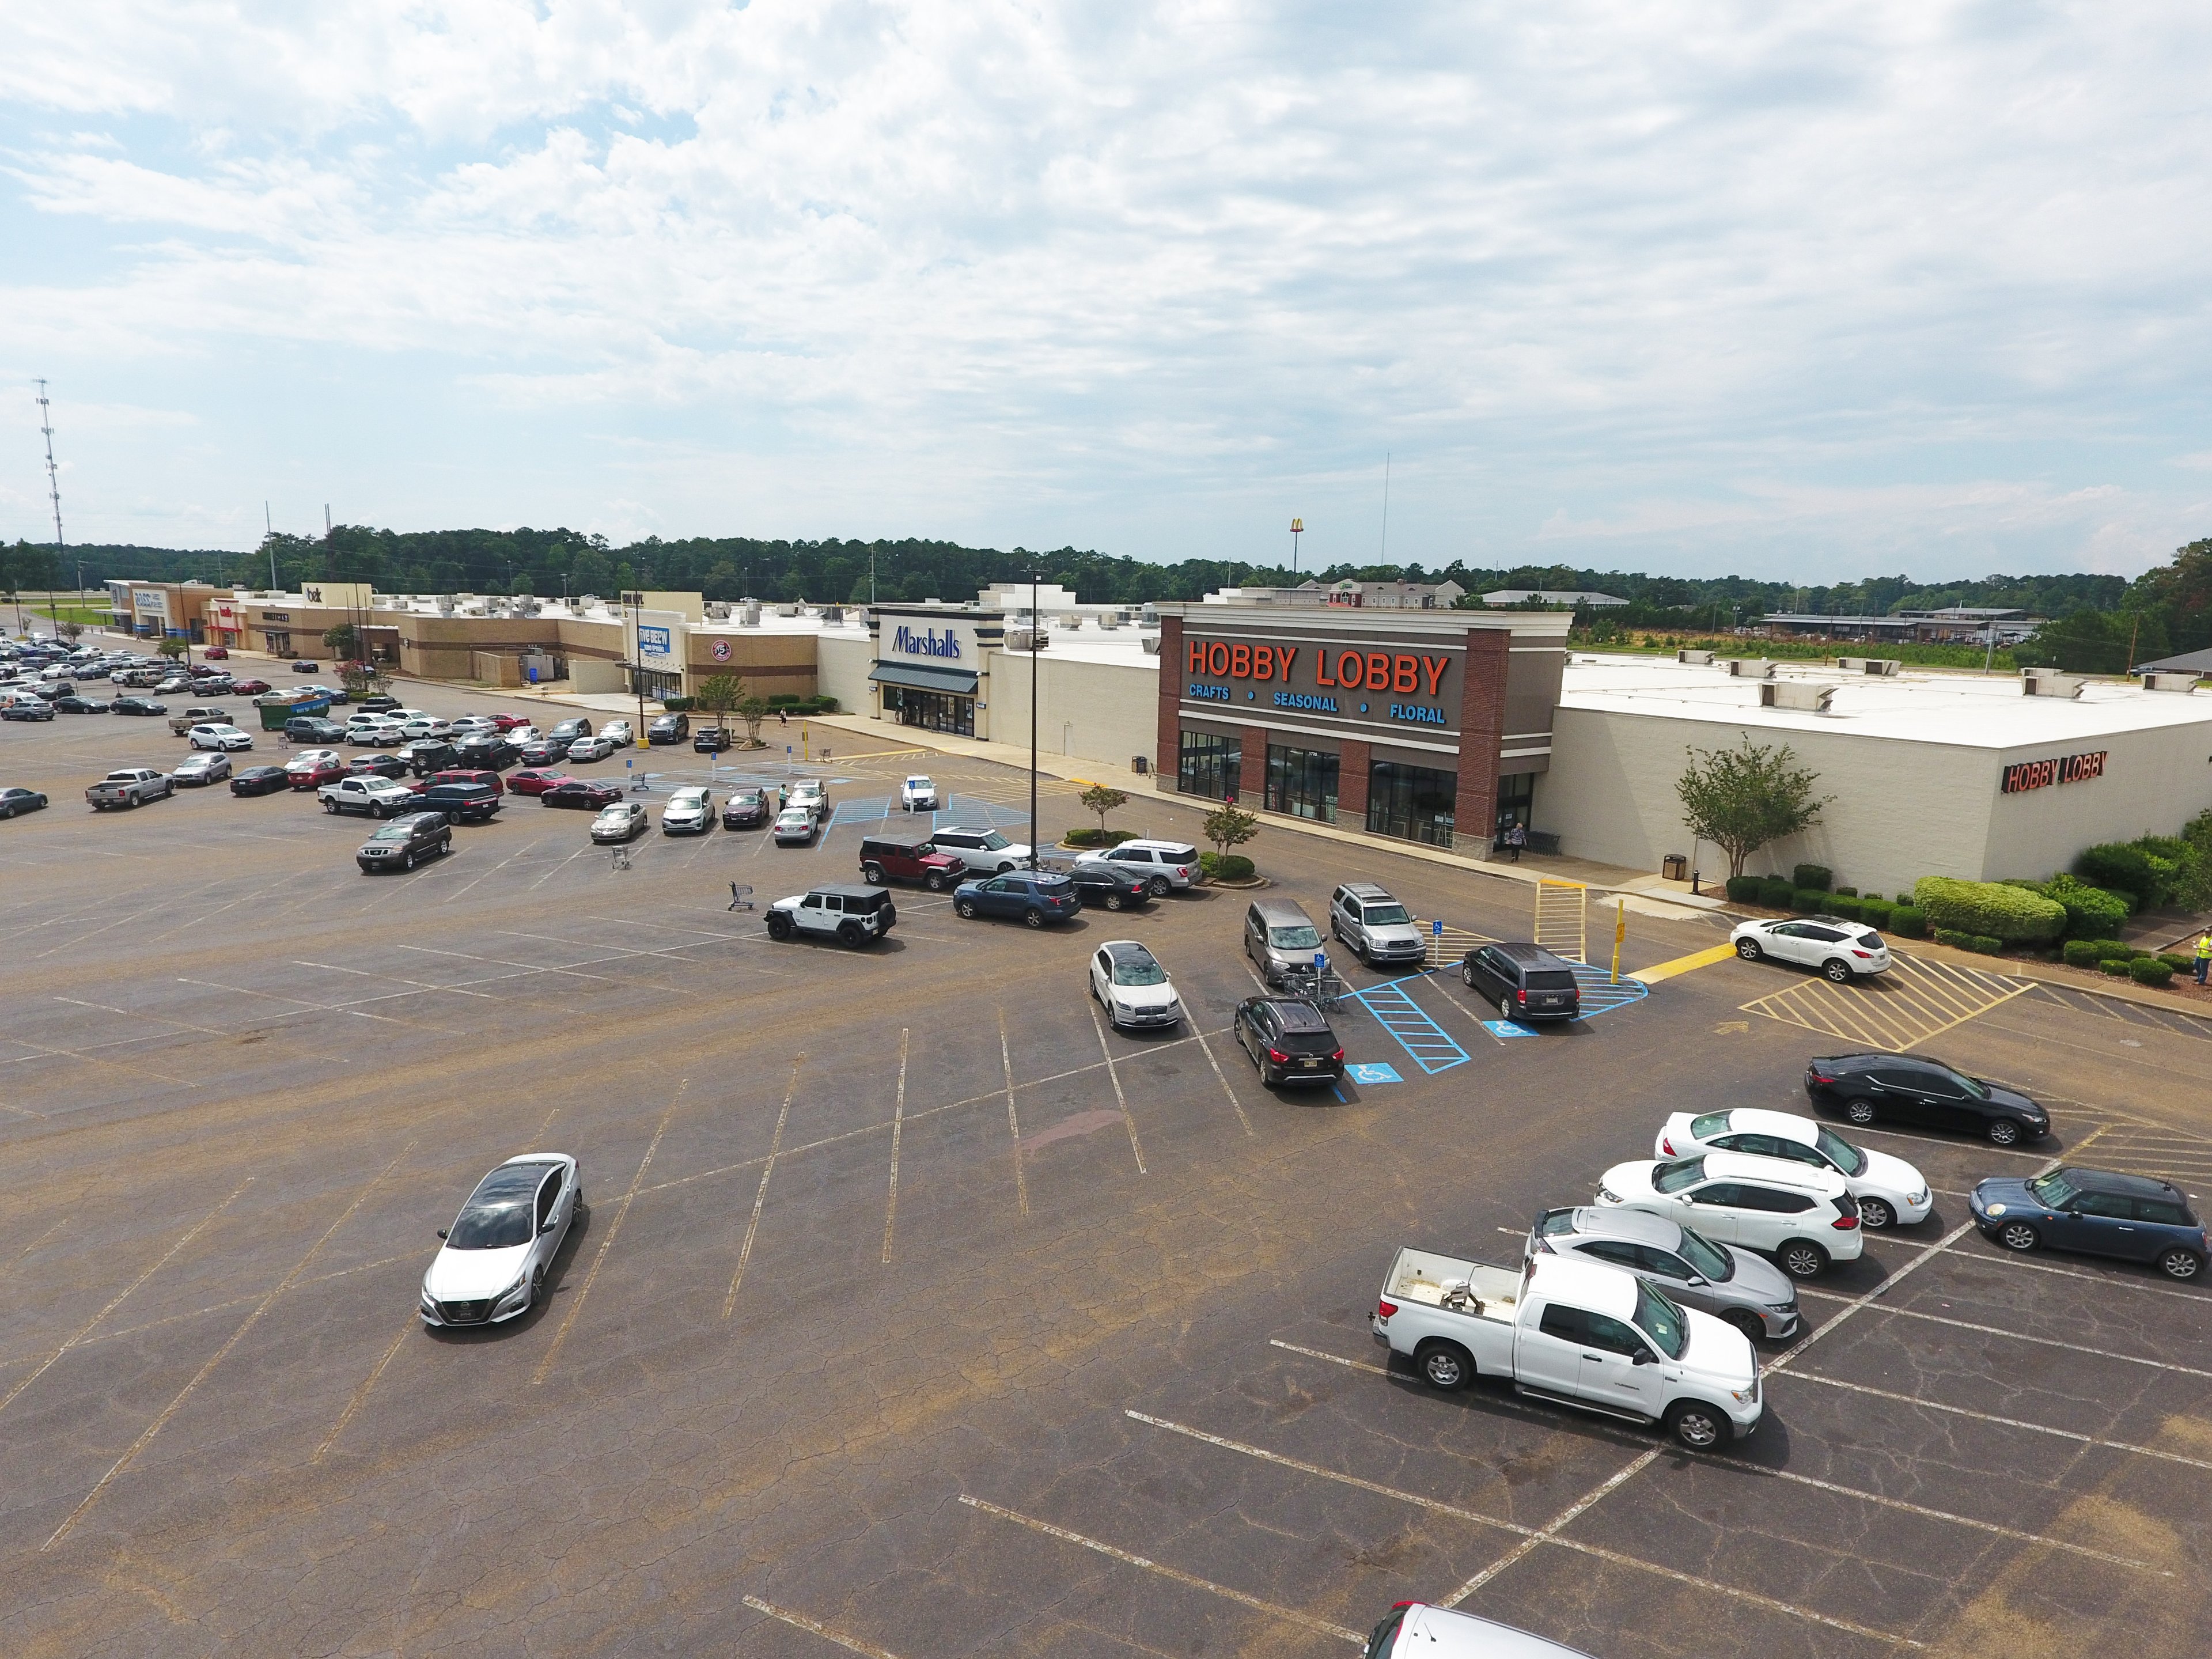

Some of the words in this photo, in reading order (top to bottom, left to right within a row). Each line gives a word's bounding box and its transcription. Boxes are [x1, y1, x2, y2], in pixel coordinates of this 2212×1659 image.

[892, 626, 961, 659] Marshalls
[1188, 640, 1298, 682] HOBBY
[1316, 649, 1450, 696] LOBBY
[1189, 683, 1230, 700] CRAFTS
[1274, 691, 1339, 713] SEASONAL
[1389, 703, 1446, 725] FLORAL
[2005, 759, 2060, 794] HOBBY
[2062, 751, 2109, 783] LOBBY
